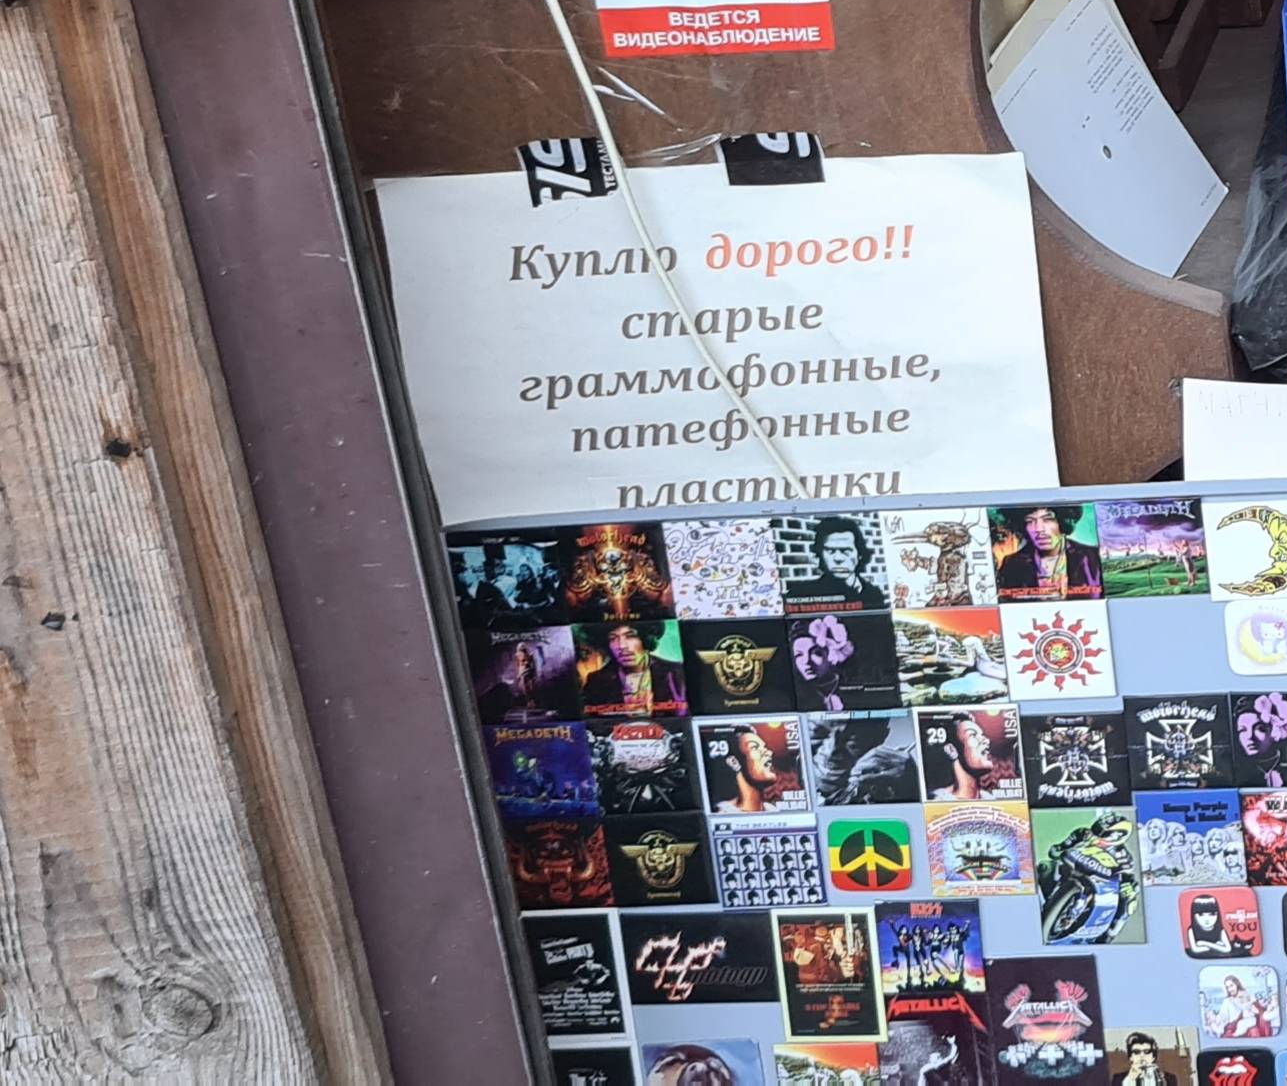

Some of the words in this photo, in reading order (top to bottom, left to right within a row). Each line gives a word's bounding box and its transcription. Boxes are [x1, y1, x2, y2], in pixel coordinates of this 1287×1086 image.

[668, 10, 760, 29] ВЕДЕТСЯ
[613, 27, 821, 49] ВИДЕОНАБЛЮДЕНИЕ
[509, 243, 677, 289] Куплю
[705, 224, 914, 277] дорого!!
[621, 303, 823, 343] старые
[518, 352, 942, 410] граммофонные,
[572, 408, 910, 452] патефонные
[617, 470, 902, 509] пластинки
[495, 726, 574, 745] MEGADETH
[784, 720, 801, 751] USA
[927, 727, 948, 744] 29
[1005, 710, 1019, 739] USA
[708, 739, 730, 757] 29
[1228, 921, 1257, 932] YOU
[886, 993, 988, 1033] METALLICA
